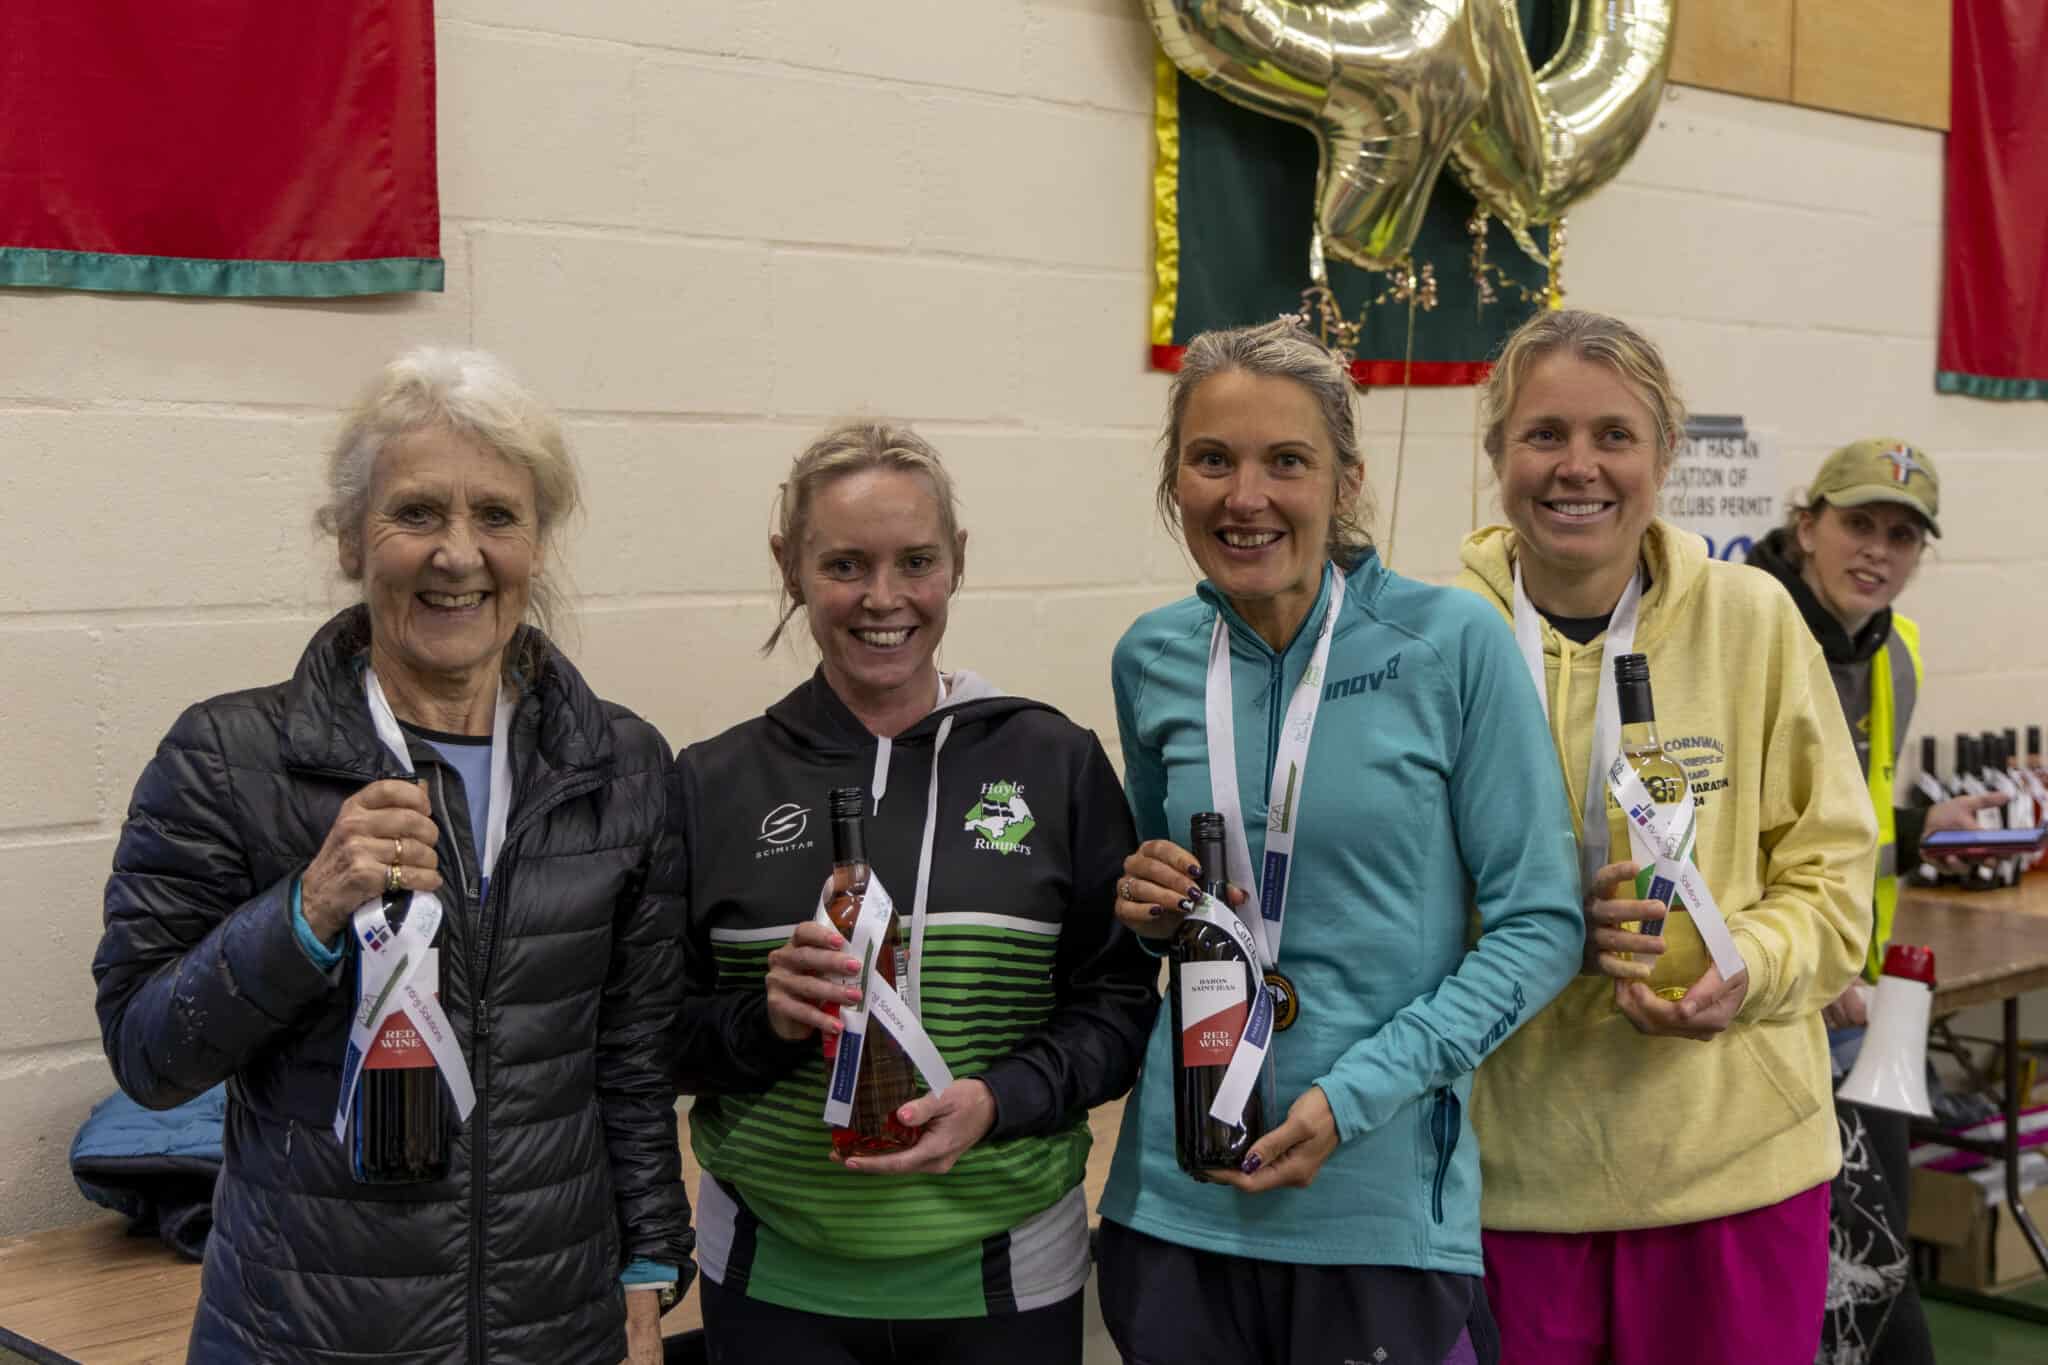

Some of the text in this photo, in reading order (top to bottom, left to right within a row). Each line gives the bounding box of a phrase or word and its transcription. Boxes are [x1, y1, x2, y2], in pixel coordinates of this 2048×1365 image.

[1705, 440, 1734, 459] HAS
[1742, 440, 1759, 459] AN
[1727, 467, 1748, 488] OF
[1669, 496, 1773, 517] CLUBS PERMIT
[1663, 735, 1725, 754] CORNWALL
[755, 840, 814, 860] SCIMITAR
[974, 837, 1032, 856] Runners
[381, 1039, 422, 1049] WINE
[384, 1030, 416, 1039] RED
[1199, 1039, 1233, 1049] WINE
[1203, 1031, 1230, 1040] RED
